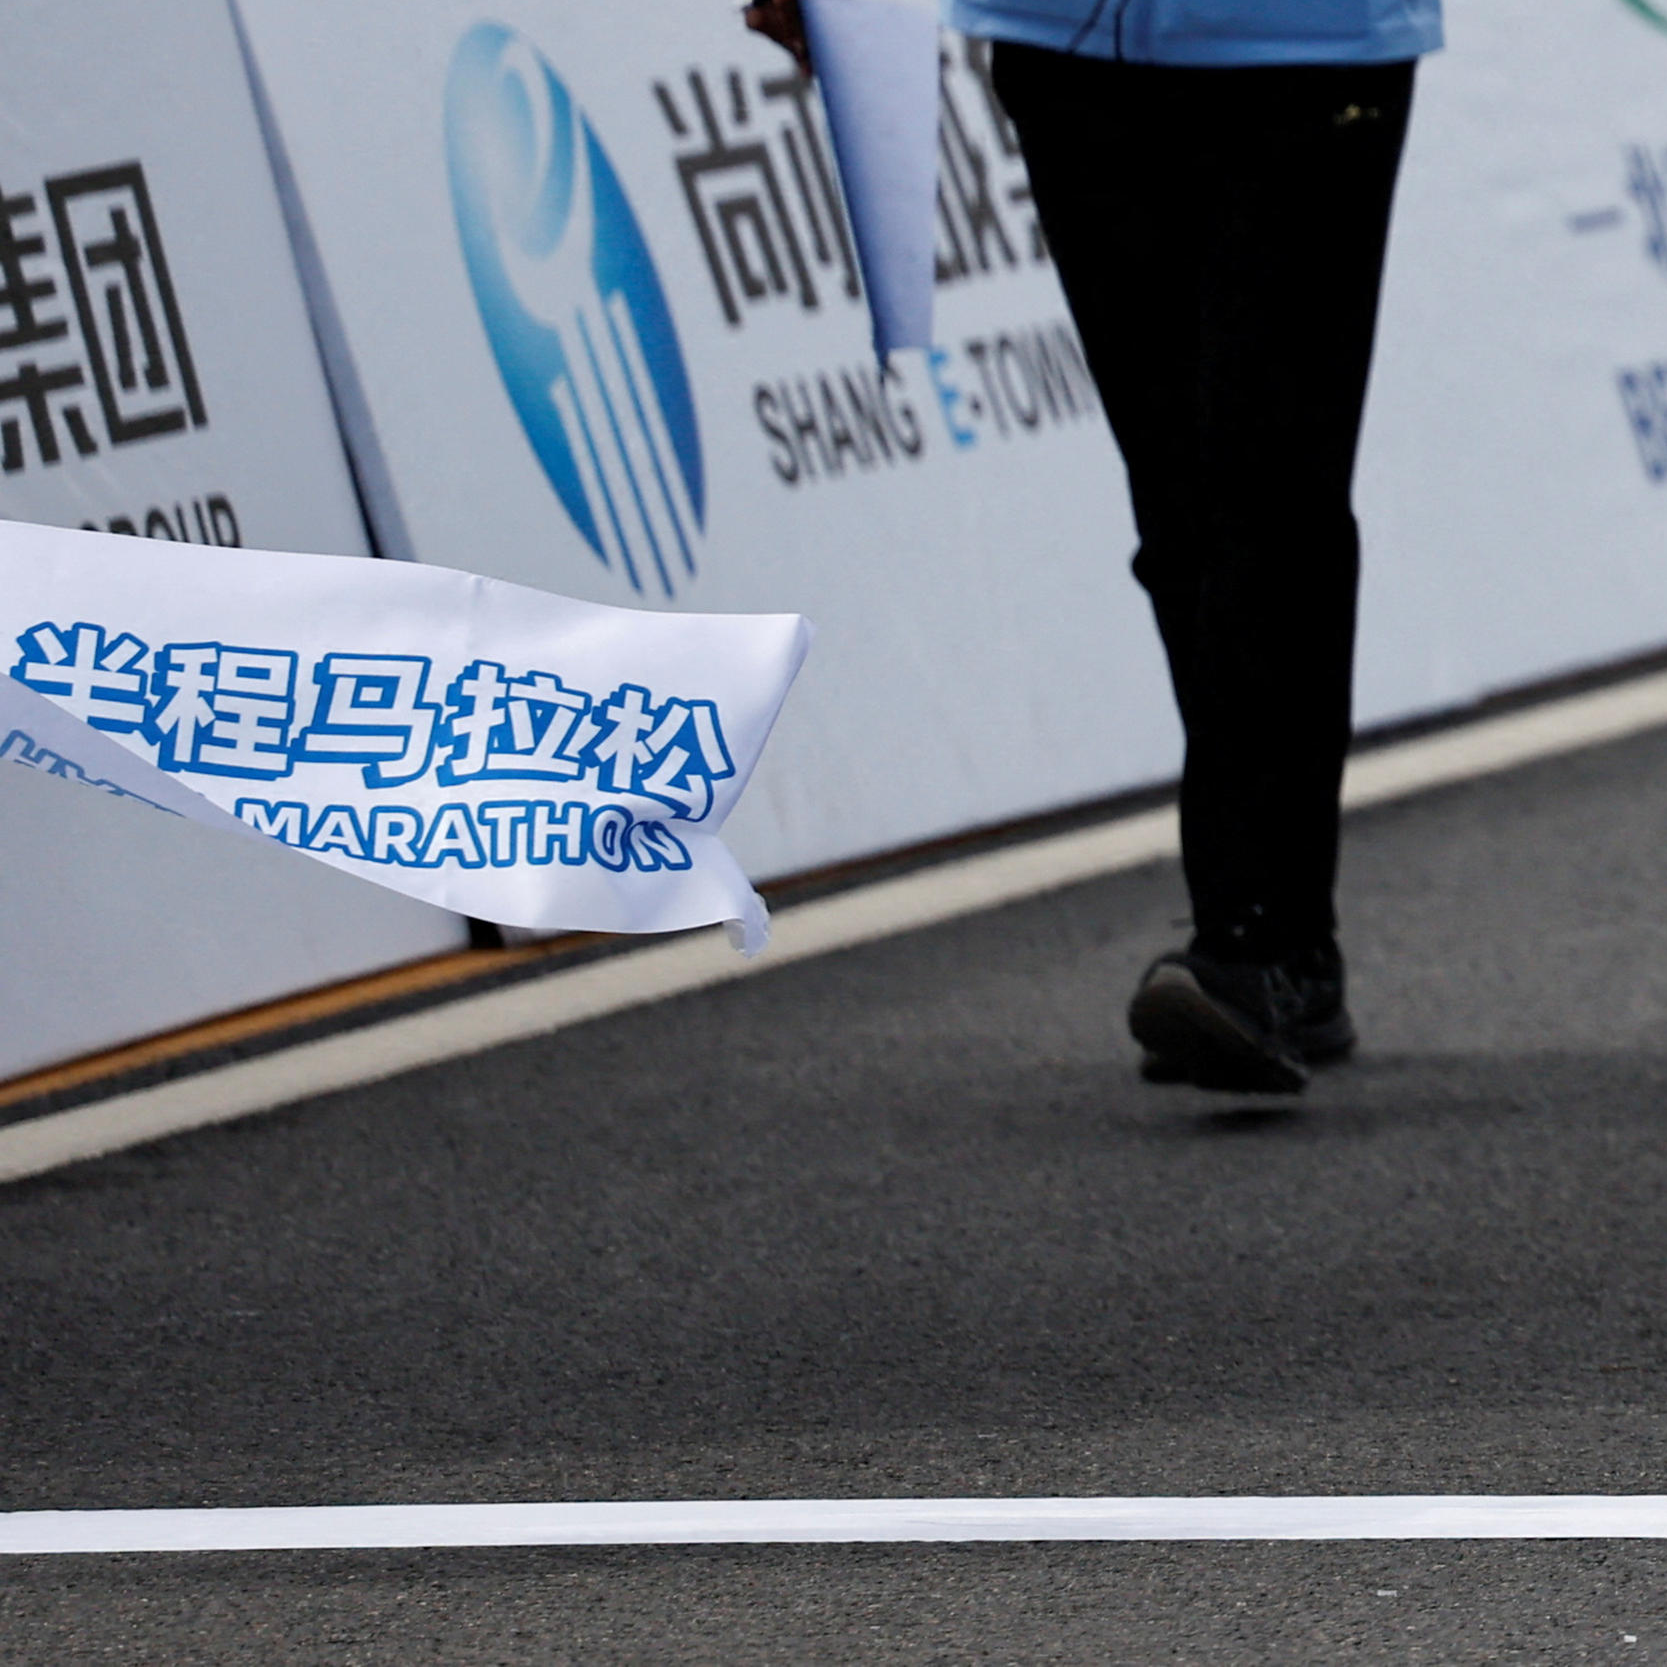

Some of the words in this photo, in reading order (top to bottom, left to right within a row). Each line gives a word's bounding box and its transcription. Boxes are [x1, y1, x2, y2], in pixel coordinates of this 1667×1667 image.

[753, 358, 925, 487] SHANG
[9, 621, 738, 826] 半程马拉松
[235, 798, 695, 873] MARATHON
